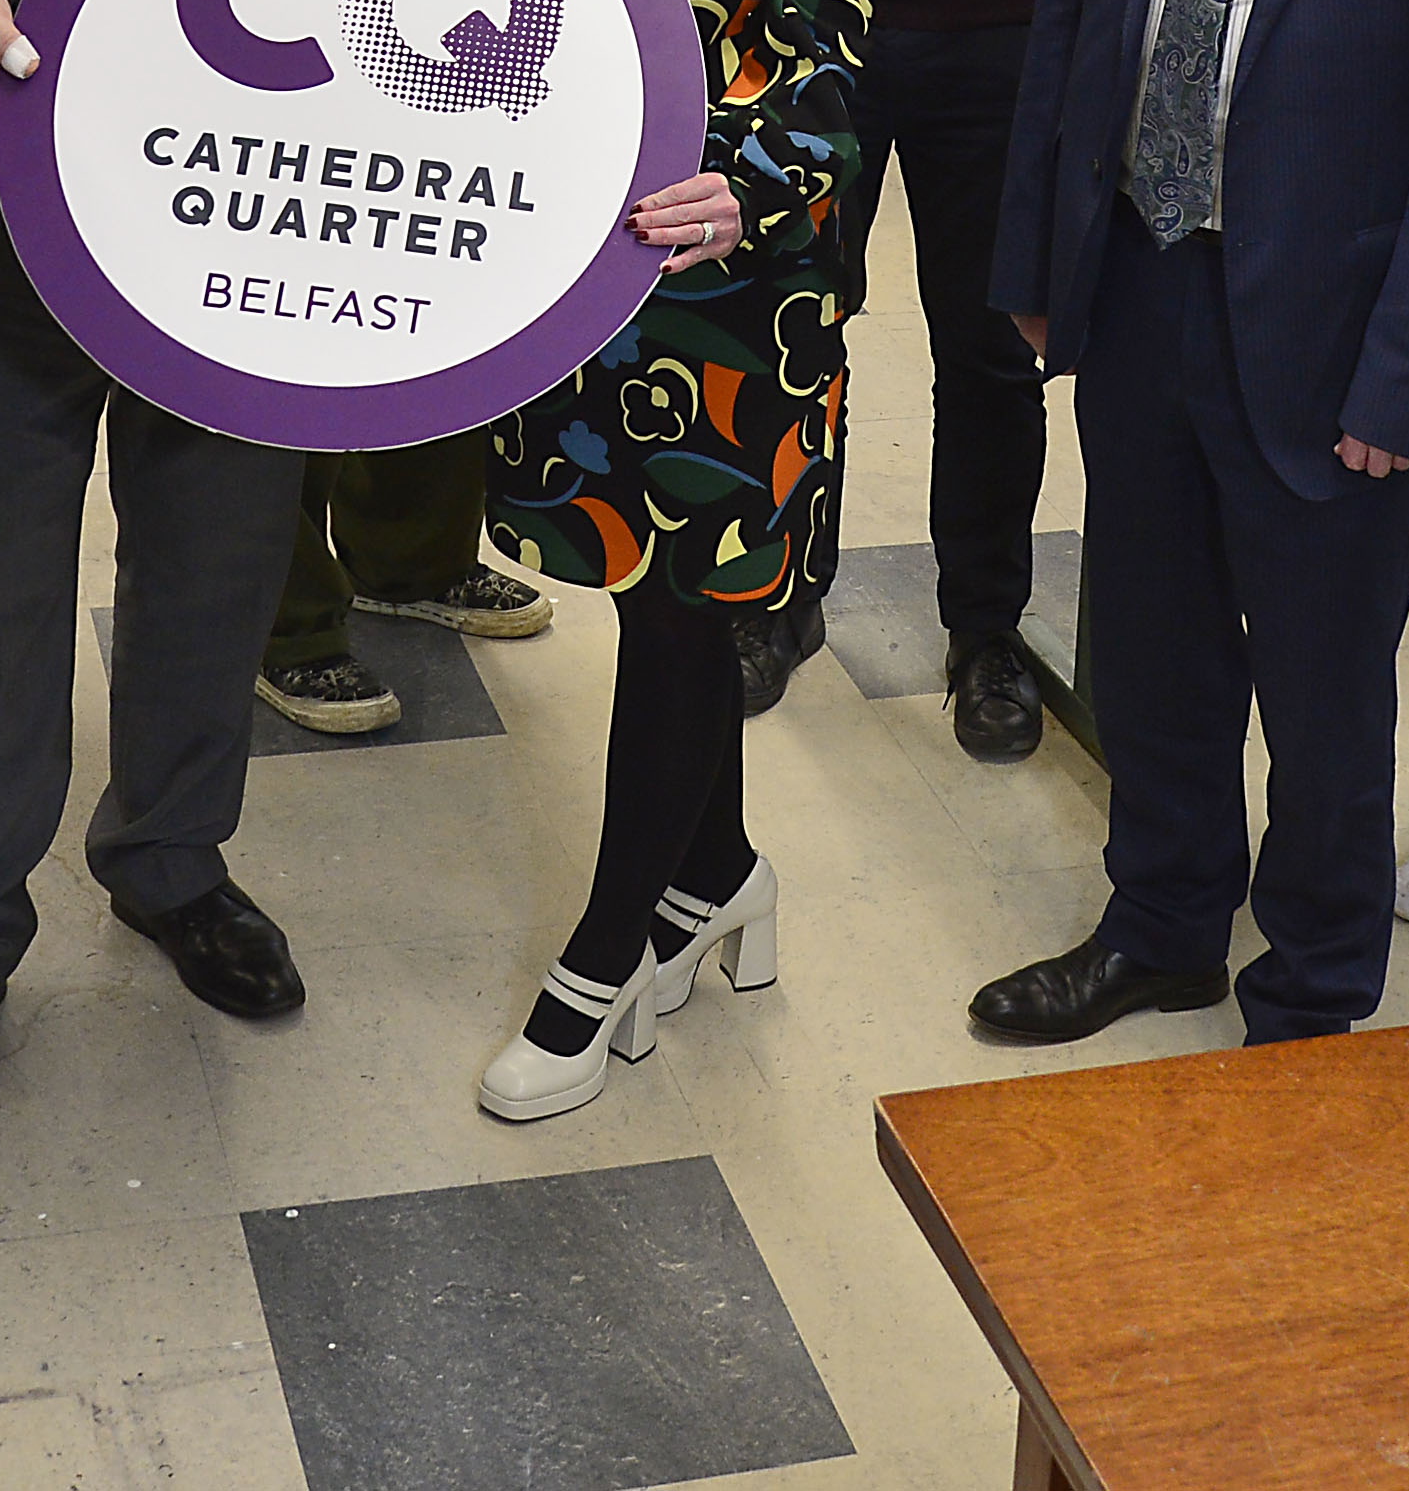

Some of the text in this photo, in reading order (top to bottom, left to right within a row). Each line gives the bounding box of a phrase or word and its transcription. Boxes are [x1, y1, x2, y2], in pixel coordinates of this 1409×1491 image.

[143, 127, 535, 213] CATHEDRAL
[172, 185, 488, 262] QUARTER
[202, 272, 431, 335] BELFAST
